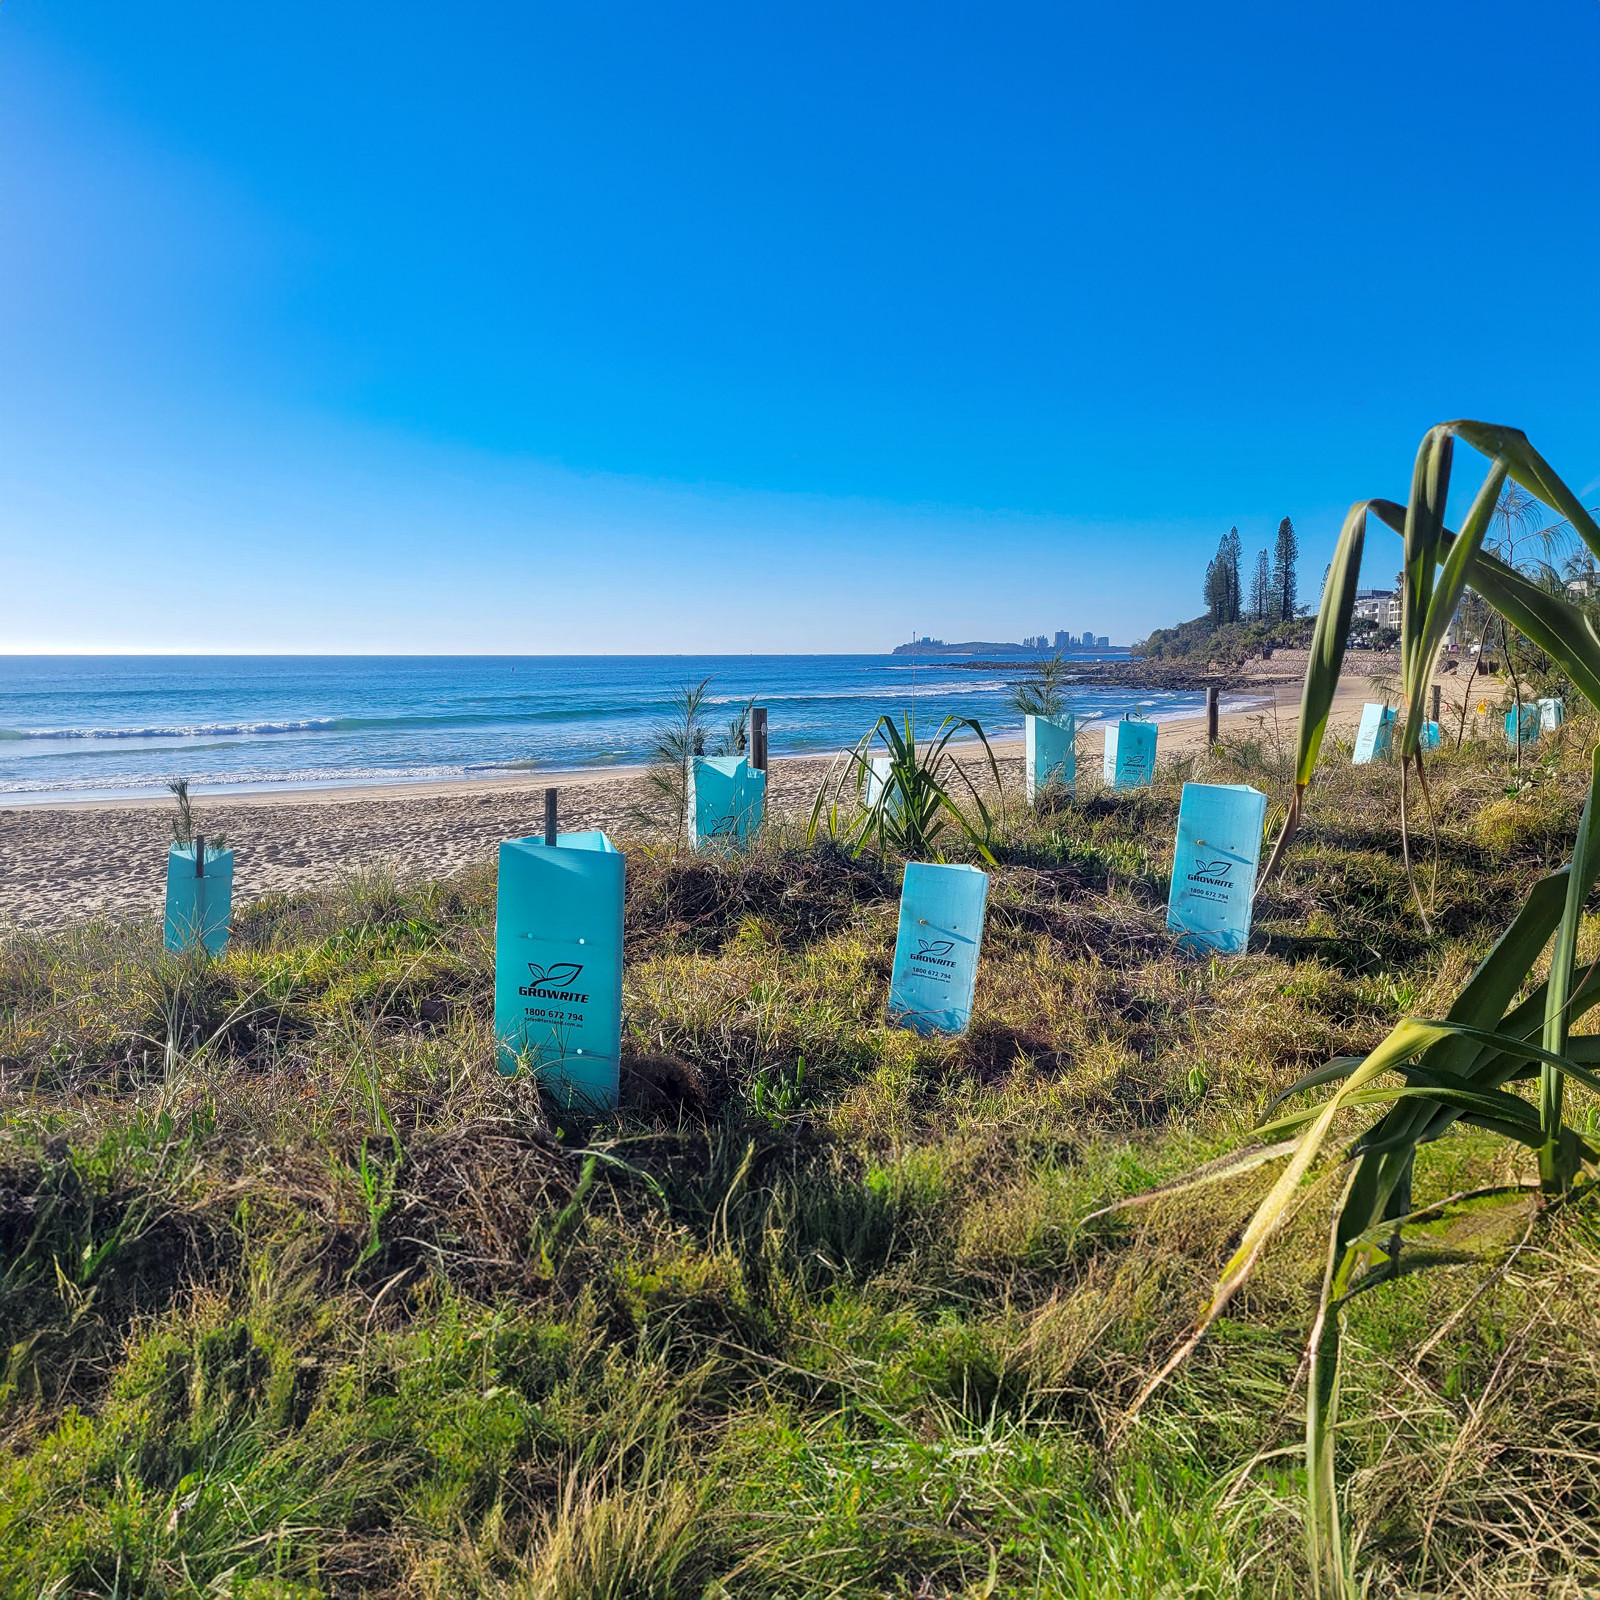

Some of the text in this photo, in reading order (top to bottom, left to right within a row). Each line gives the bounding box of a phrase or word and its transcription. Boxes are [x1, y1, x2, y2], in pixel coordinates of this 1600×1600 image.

[1187, 873, 1235, 889] GROWRITE
[1190, 887, 1204, 895] 1800
[1205, 889, 1217, 897] 672
[1218, 892, 1229, 900] 794
[910, 953, 957, 968] GROWRITE
[928, 969, 939, 977] 672
[940, 972, 951, 980] 794
[519, 986, 590, 1004] GROWRITE
[524, 1007, 584, 1022] 1800 672 794
